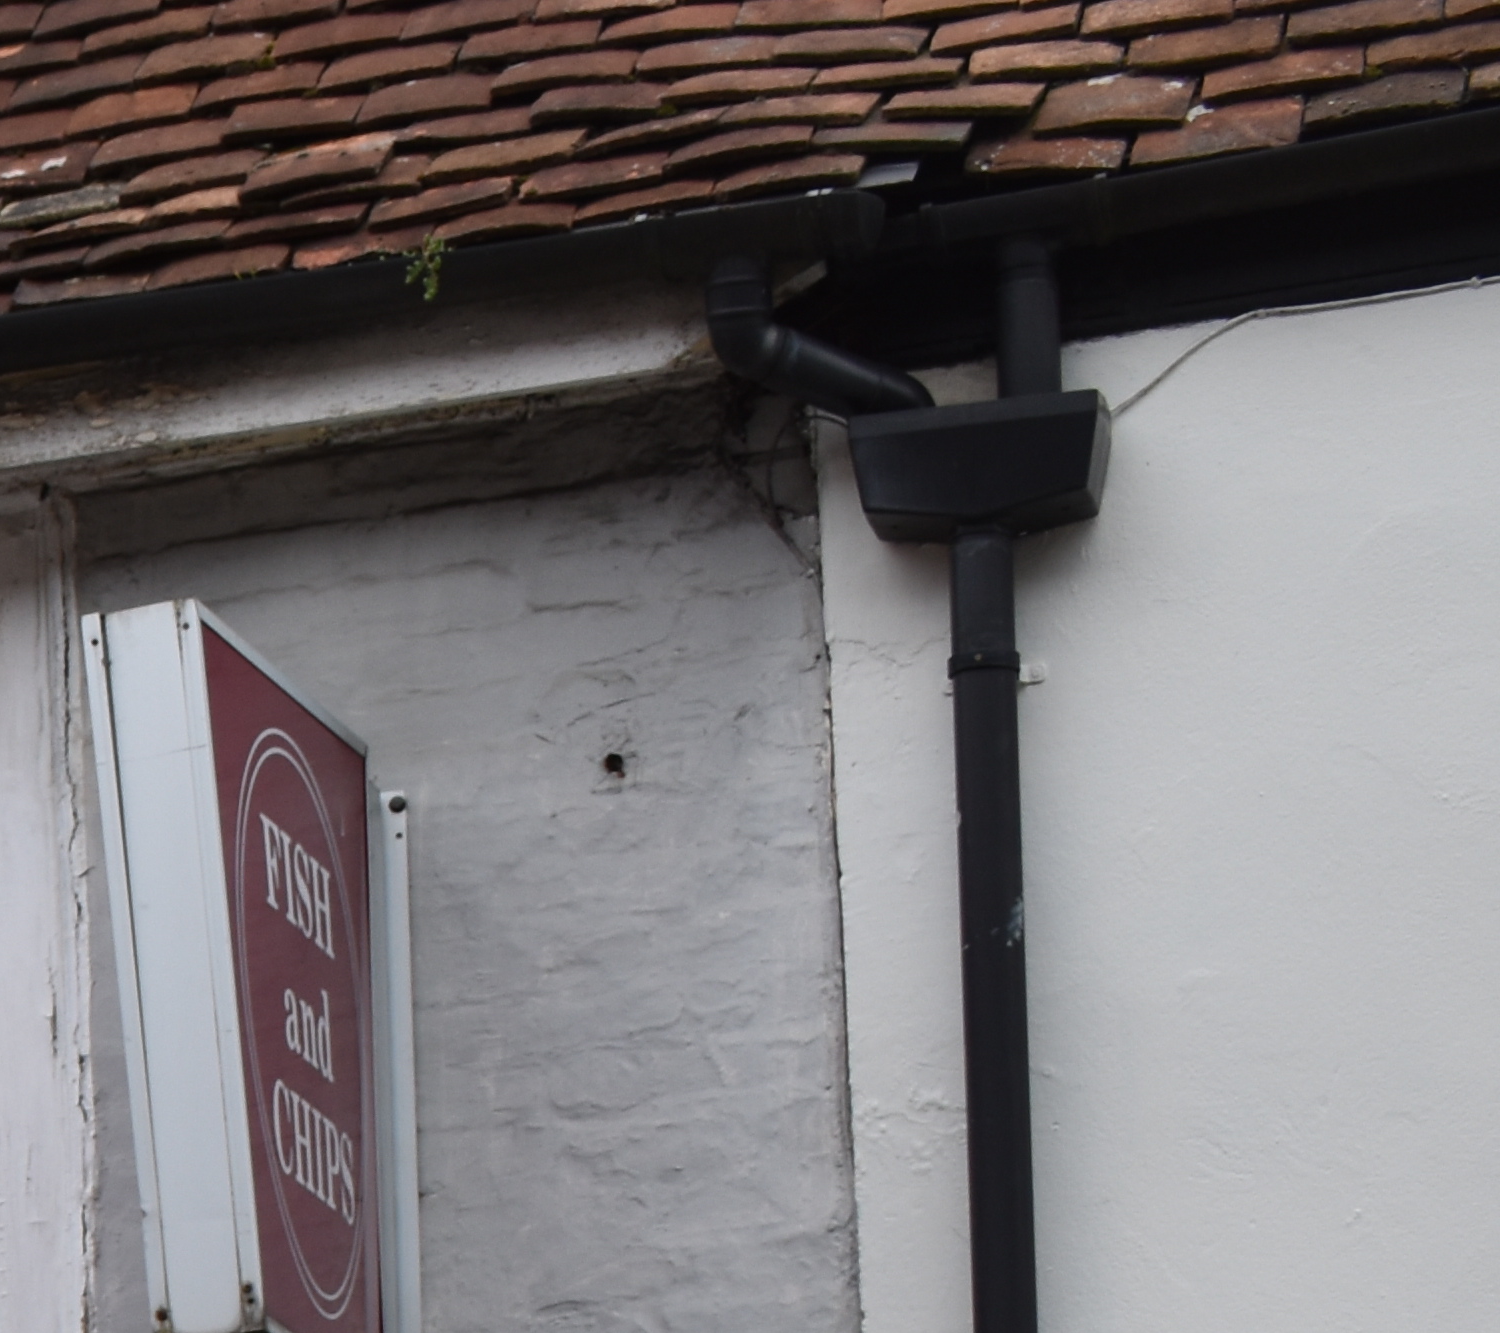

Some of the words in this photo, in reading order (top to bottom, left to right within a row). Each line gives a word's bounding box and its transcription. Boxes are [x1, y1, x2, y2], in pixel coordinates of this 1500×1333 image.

[259, 812, 335, 960] FISH
[284, 989, 334, 1083] and
[271, 1077, 355, 1228] CHIPS
